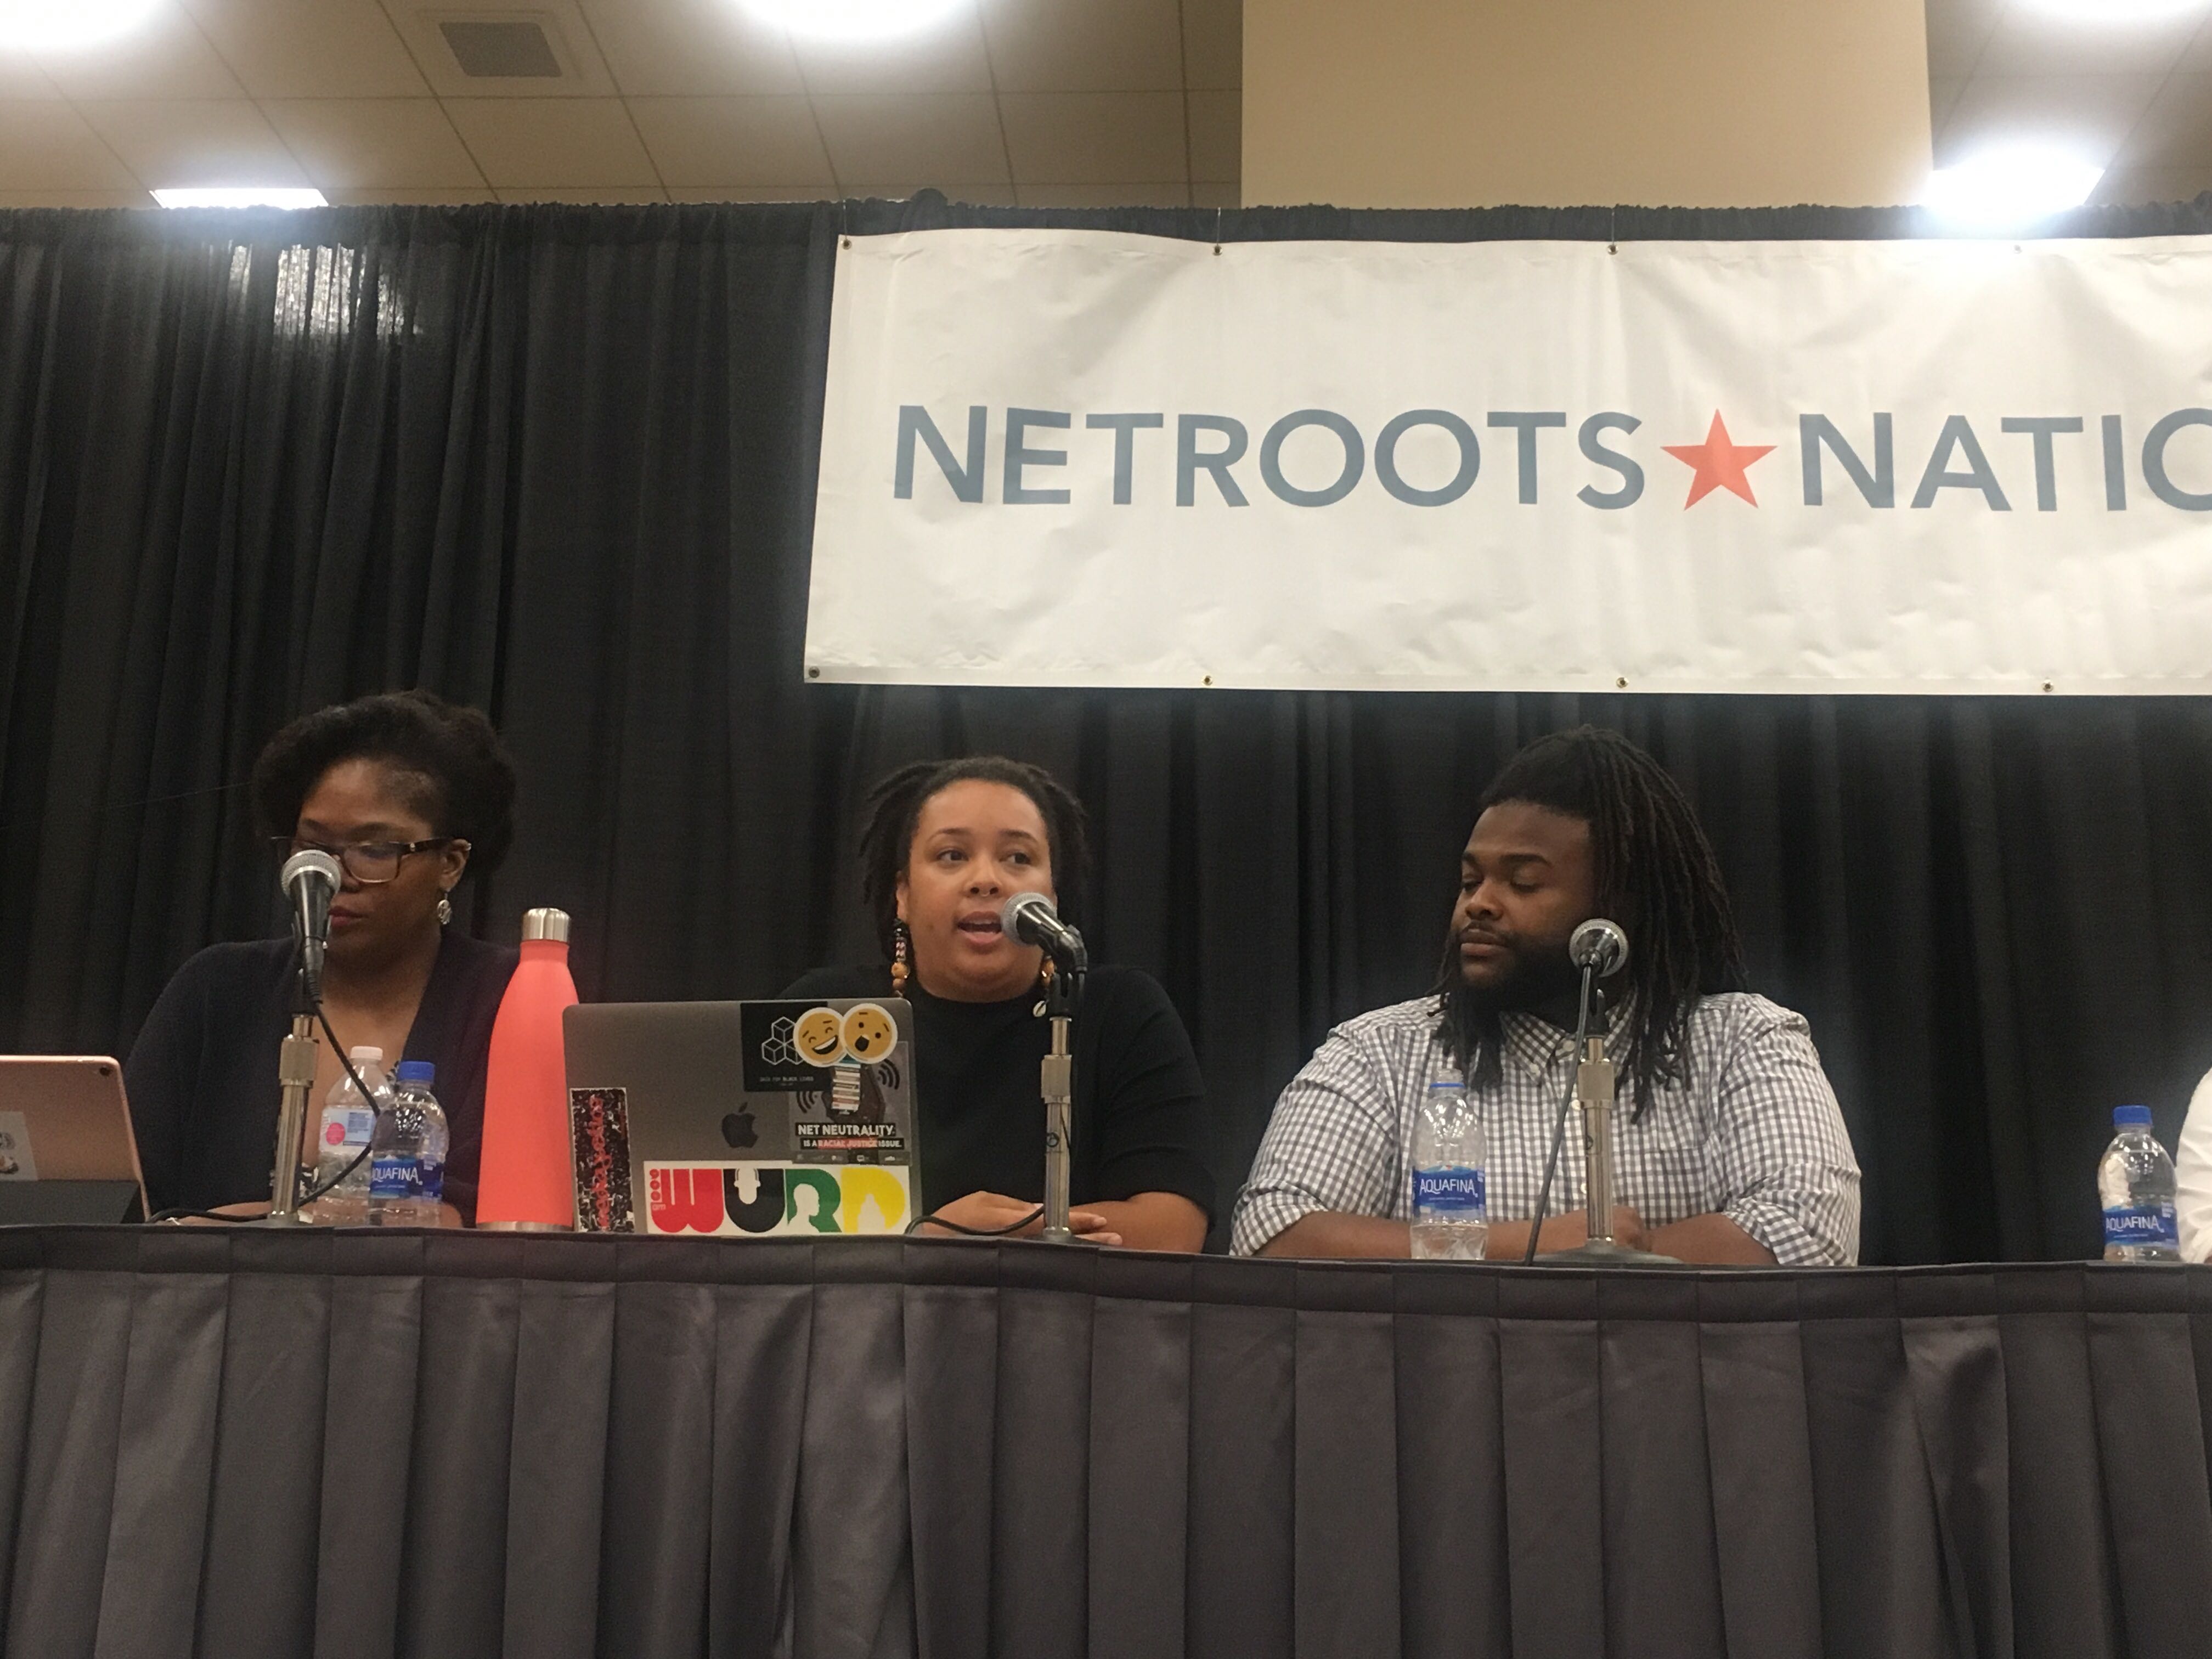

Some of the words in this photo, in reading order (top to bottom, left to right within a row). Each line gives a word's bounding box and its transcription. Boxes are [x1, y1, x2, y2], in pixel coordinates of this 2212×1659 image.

[894, 407, 1645, 509] NETROOTS
[798, 1125, 820, 1135] NET
[823, 1124, 894, 1137] NEUTRALITY
[818, 1139, 846, 1148] RACIAL
[847, 1139, 878, 1148] JUSTICE
[1419, 1178, 1476, 1196] AQUAFINA
